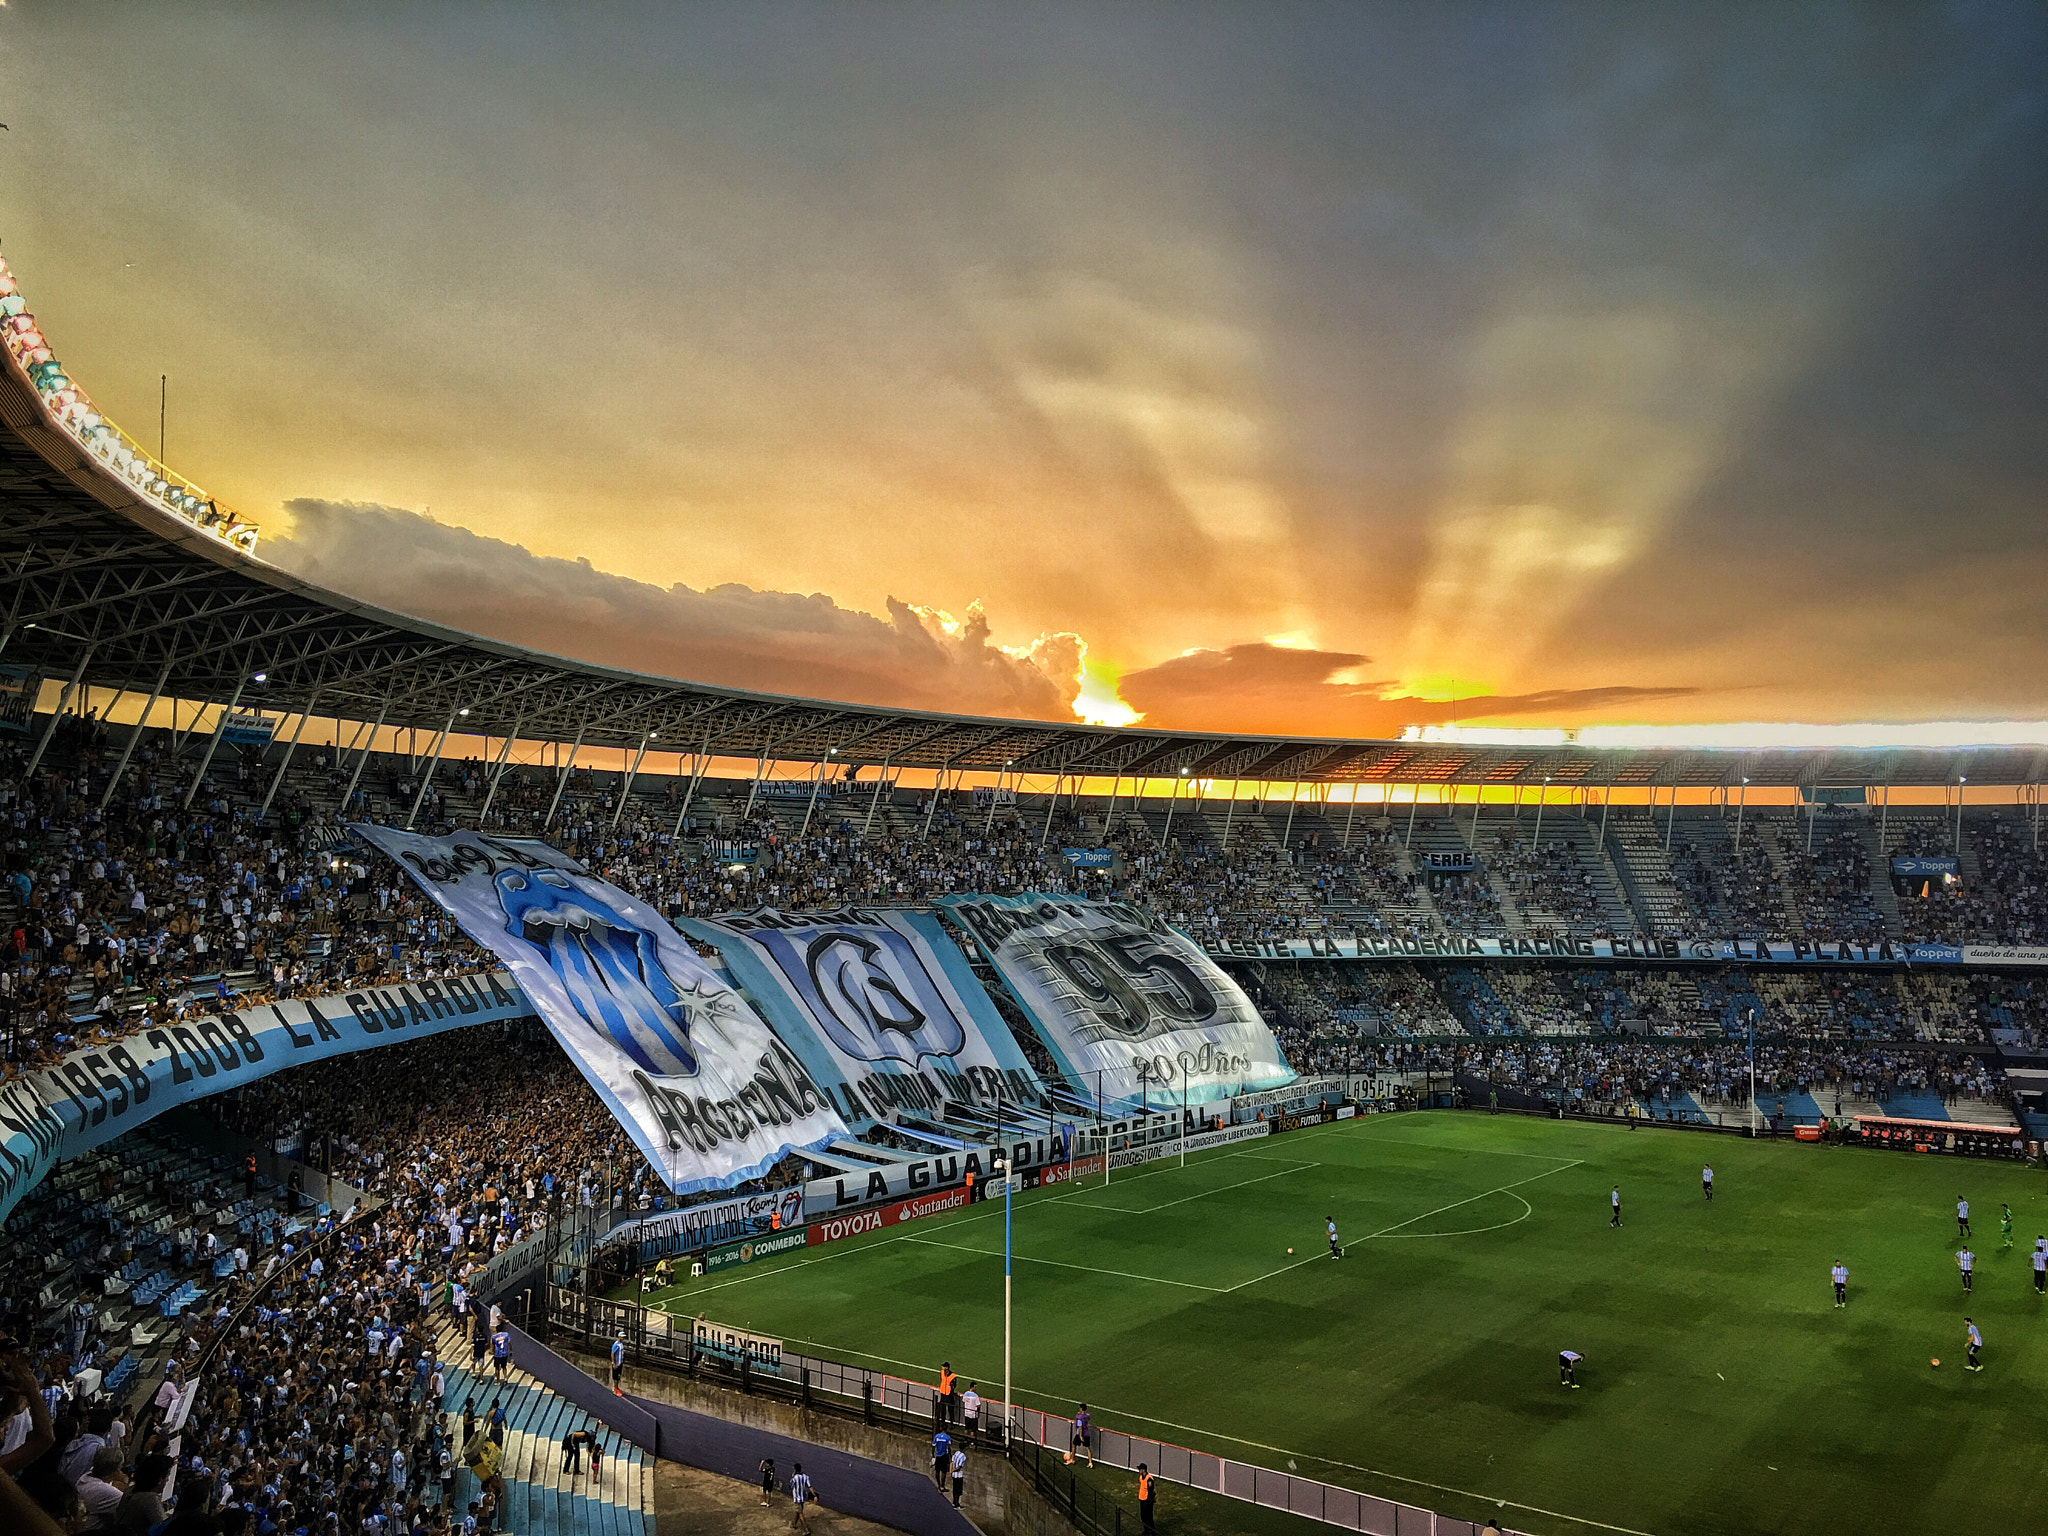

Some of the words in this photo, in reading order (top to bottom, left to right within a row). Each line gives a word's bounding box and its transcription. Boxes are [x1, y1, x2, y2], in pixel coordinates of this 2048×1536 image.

[795, 781, 832, 795] MORNO
[975, 791, 1012, 803] VARLA
[1083, 852, 1112, 863] Topper
[1920, 861, 1956, 872] Topper
[1201, 939, 1297, 957] ELESTE,
[1308, 939, 1343, 957] LA
[1356, 938, 1484, 957] ACADEMIA
[1501, 939, 1594, 957] RACING
[1611, 940, 1681, 958] CLUB
[1733, 942, 1772, 960] LA
[1792, 942, 1895, 961] PLATA
[2003, 949, 2016, 958] de
[1043, 934, 1217, 1036] 95
[272, 1005, 341, 1048] LA
[346, 974, 518, 1034] GUARDIA
[1132, 1054, 1176, 1086] 20
[1177, 1041, 1252, 1077] Años
[632, 1039, 830, 1154] ARGETINA
[824, 1082, 872, 1122] LA
[1173, 1139, 1189, 1152] COPA
[1228, 1125, 1268, 1140] LIBERTADORES
[836, 1171, 888, 1206] LA
[908, 1132, 1066, 1189] GUARDIA
[1077, 1106, 1211, 1154] IMPERIAL
[1057, 1161, 1101, 1182] Santander
[747, 1193, 778, 1217] Racing
[912, 1192, 965, 1218] Santander
[821, 1211, 882, 1242] TOYOTA
[755, 1233, 806, 1255] CONMEBOL
[498, 1257, 510, 1282] de
[511, 1247, 529, 1274] una
